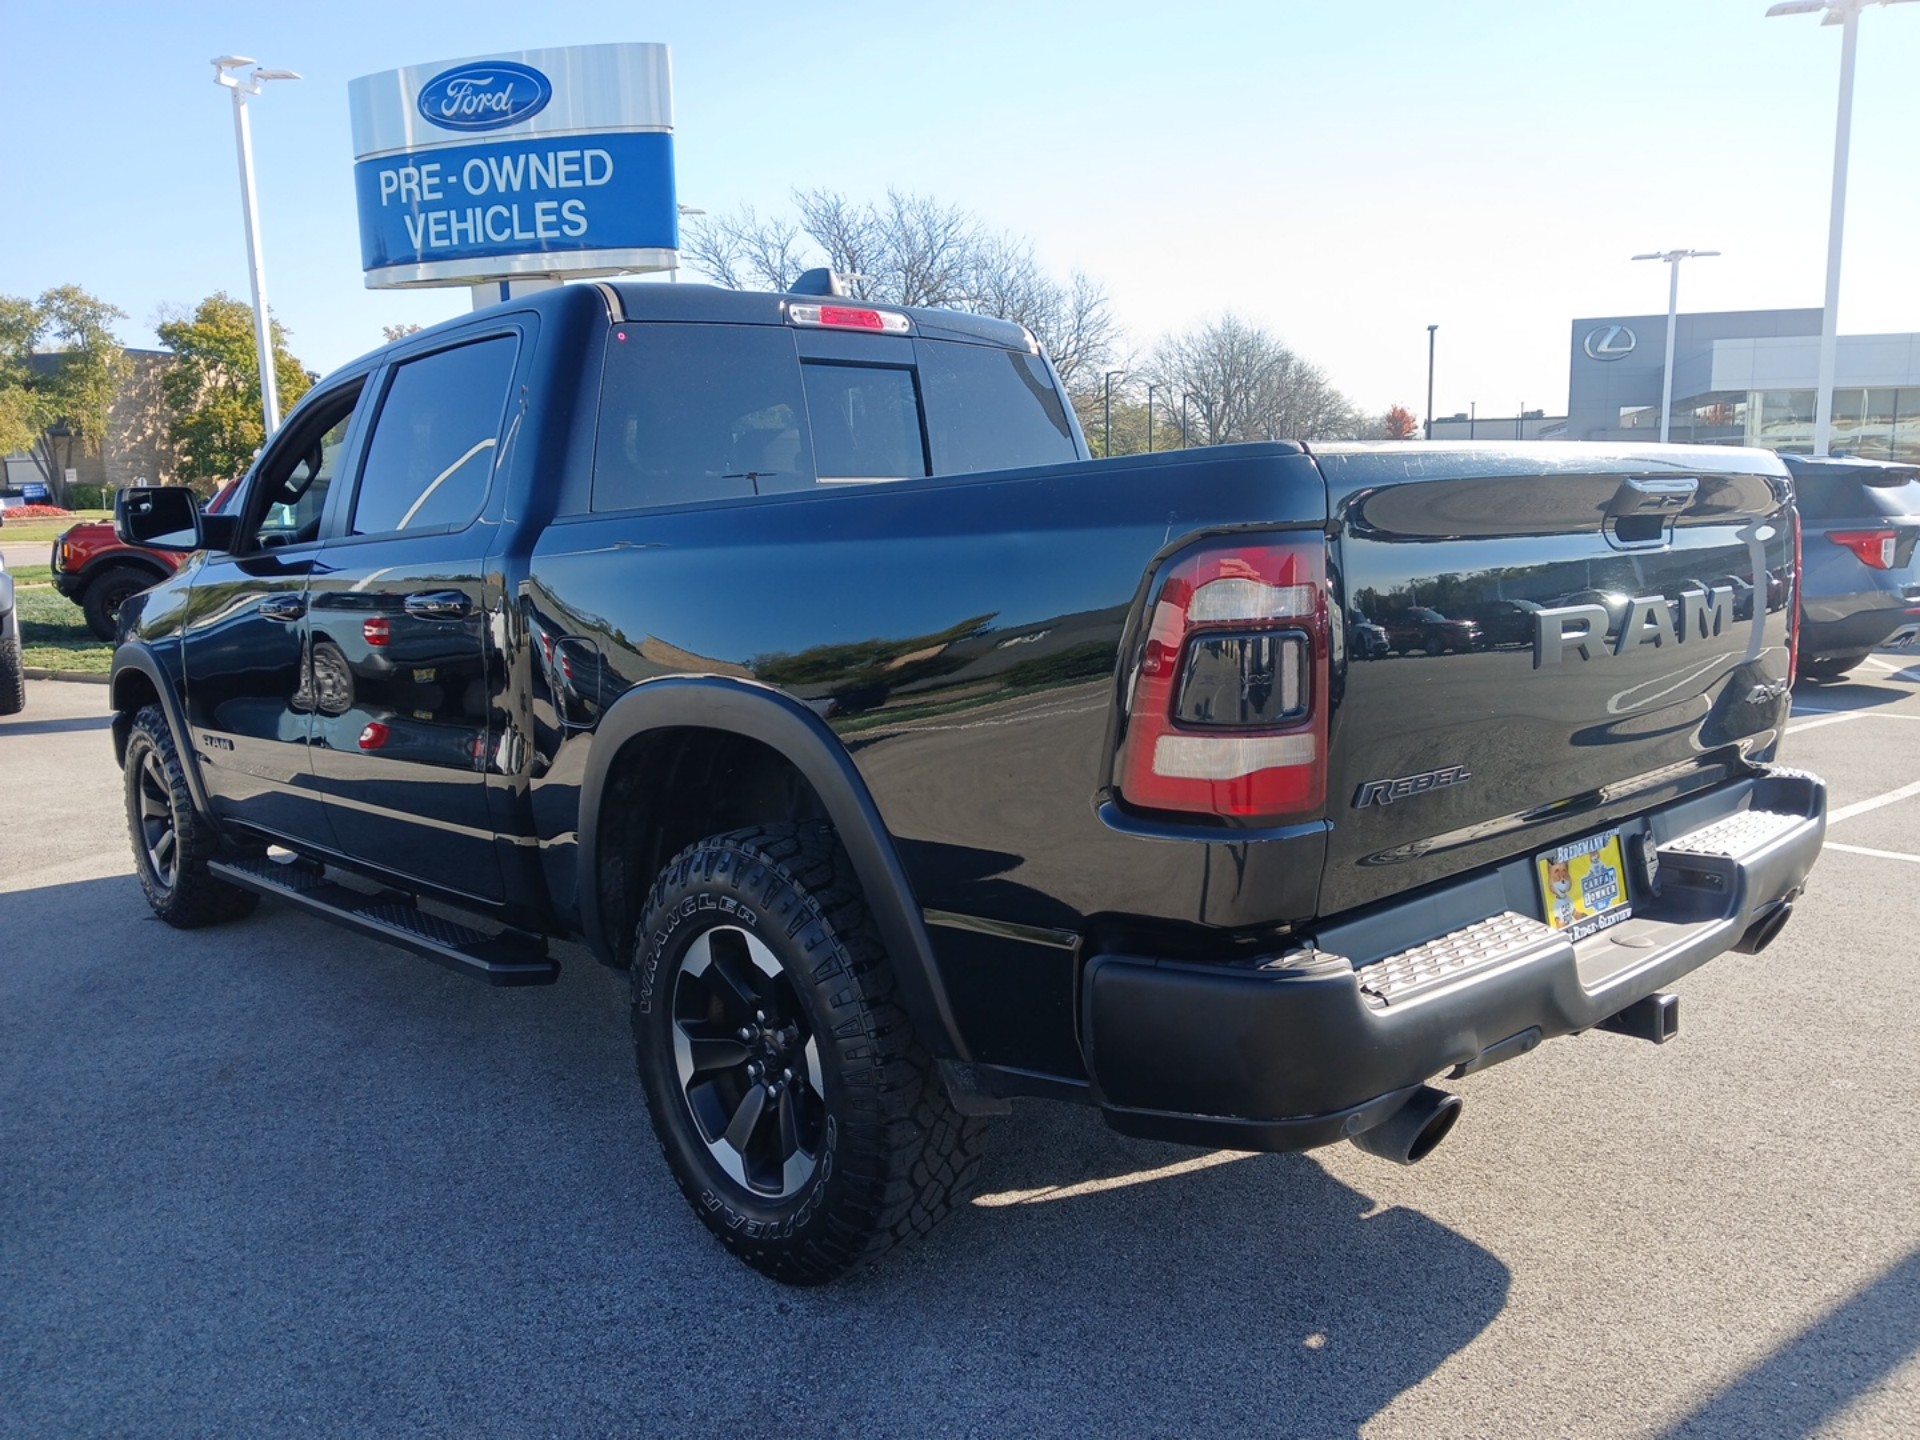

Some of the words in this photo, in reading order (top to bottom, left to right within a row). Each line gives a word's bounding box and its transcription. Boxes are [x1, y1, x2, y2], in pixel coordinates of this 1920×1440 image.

[440, 76, 514, 116] Ford
[403, 199, 589, 250] VEHICLES
[1533, 585, 1733, 670] RAM
[1351, 764, 1472, 809] REBEL
[639, 892, 757, 1014] WRANGLER
